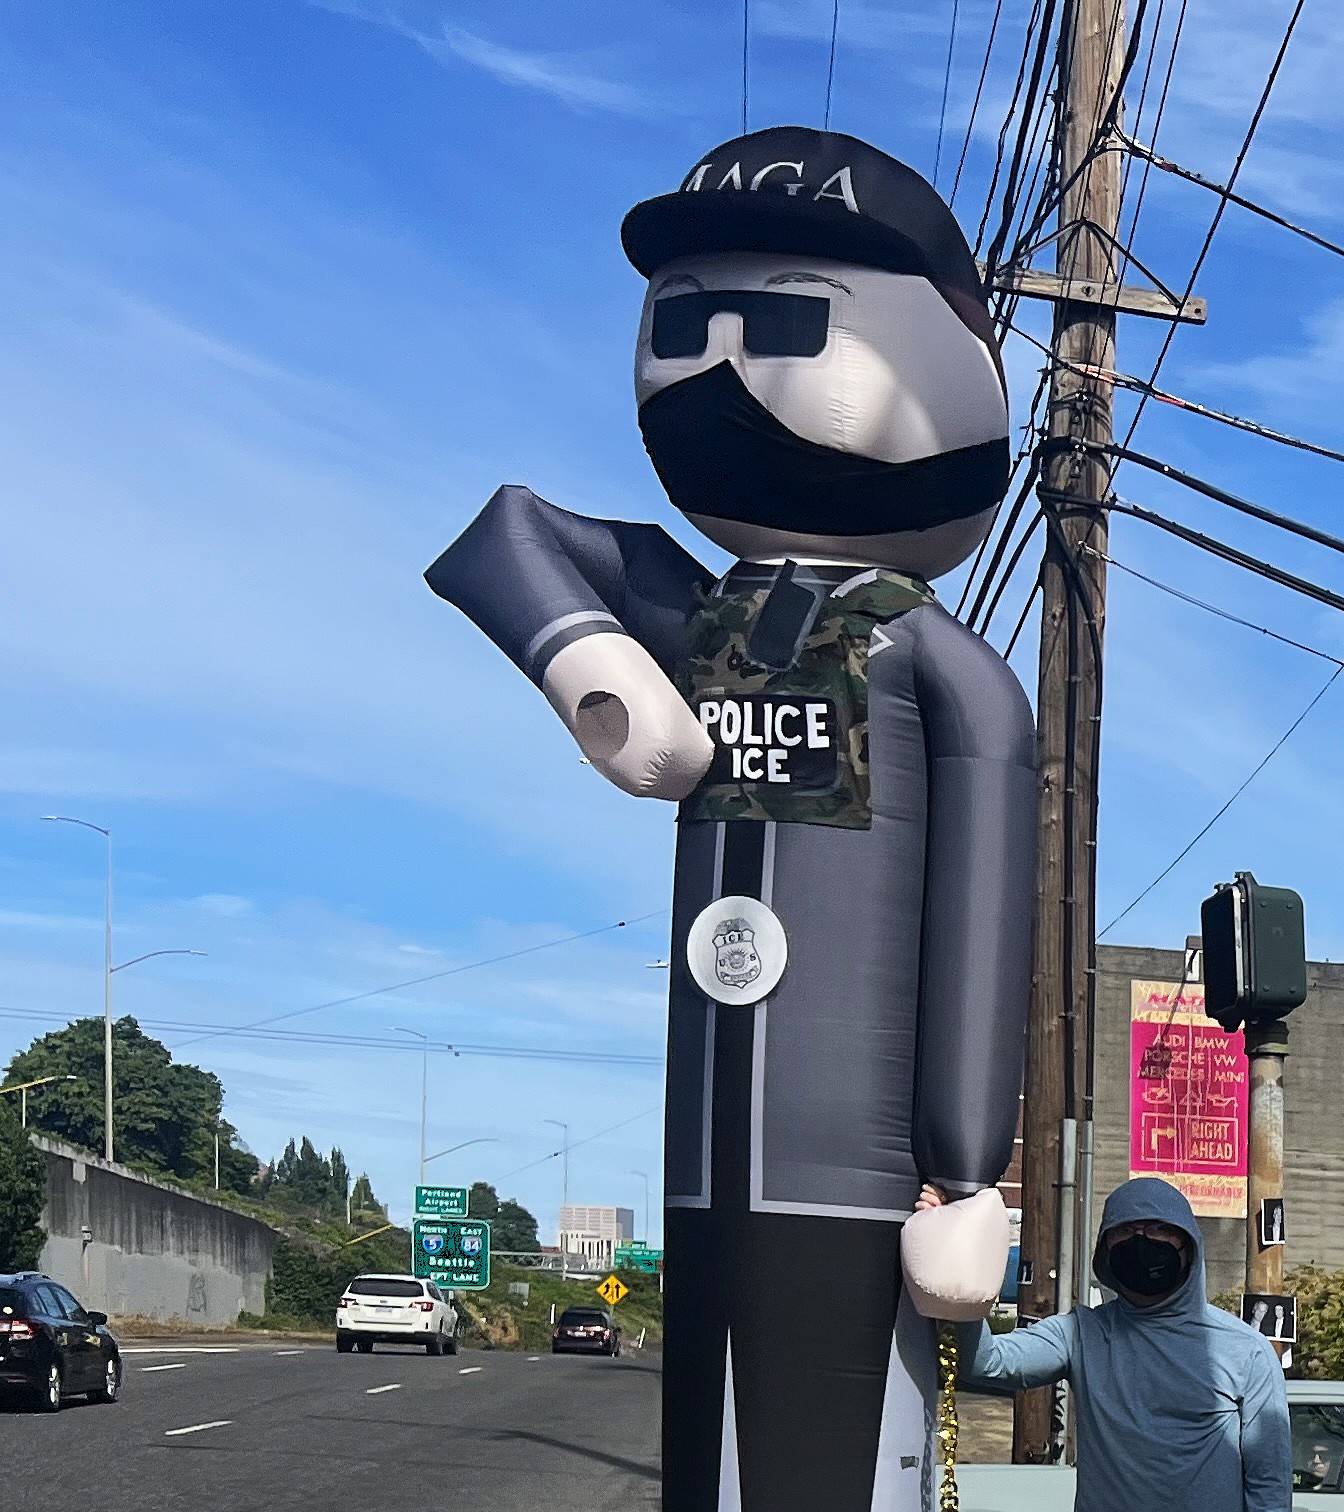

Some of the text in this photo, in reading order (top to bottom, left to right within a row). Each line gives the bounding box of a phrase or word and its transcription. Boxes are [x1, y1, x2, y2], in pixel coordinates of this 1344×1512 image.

[699, 699, 830, 750] POLICE
[732, 747, 791, 783] ICE
[1153, 1034, 1230, 1050] AUDI BMW
[1144, 1048, 1237, 1067] PORSCHE VW
[1137, 1065, 1245, 1083] MERCEDES MINI
[1191, 1121, 1230, 1140] RIGHT
[1190, 1142, 1233, 1160] AHEAD
[421, 1189, 461, 1198] Portland
[429, 1238, 437, 1250] 5
[452, 1273, 479, 1282] LANE
